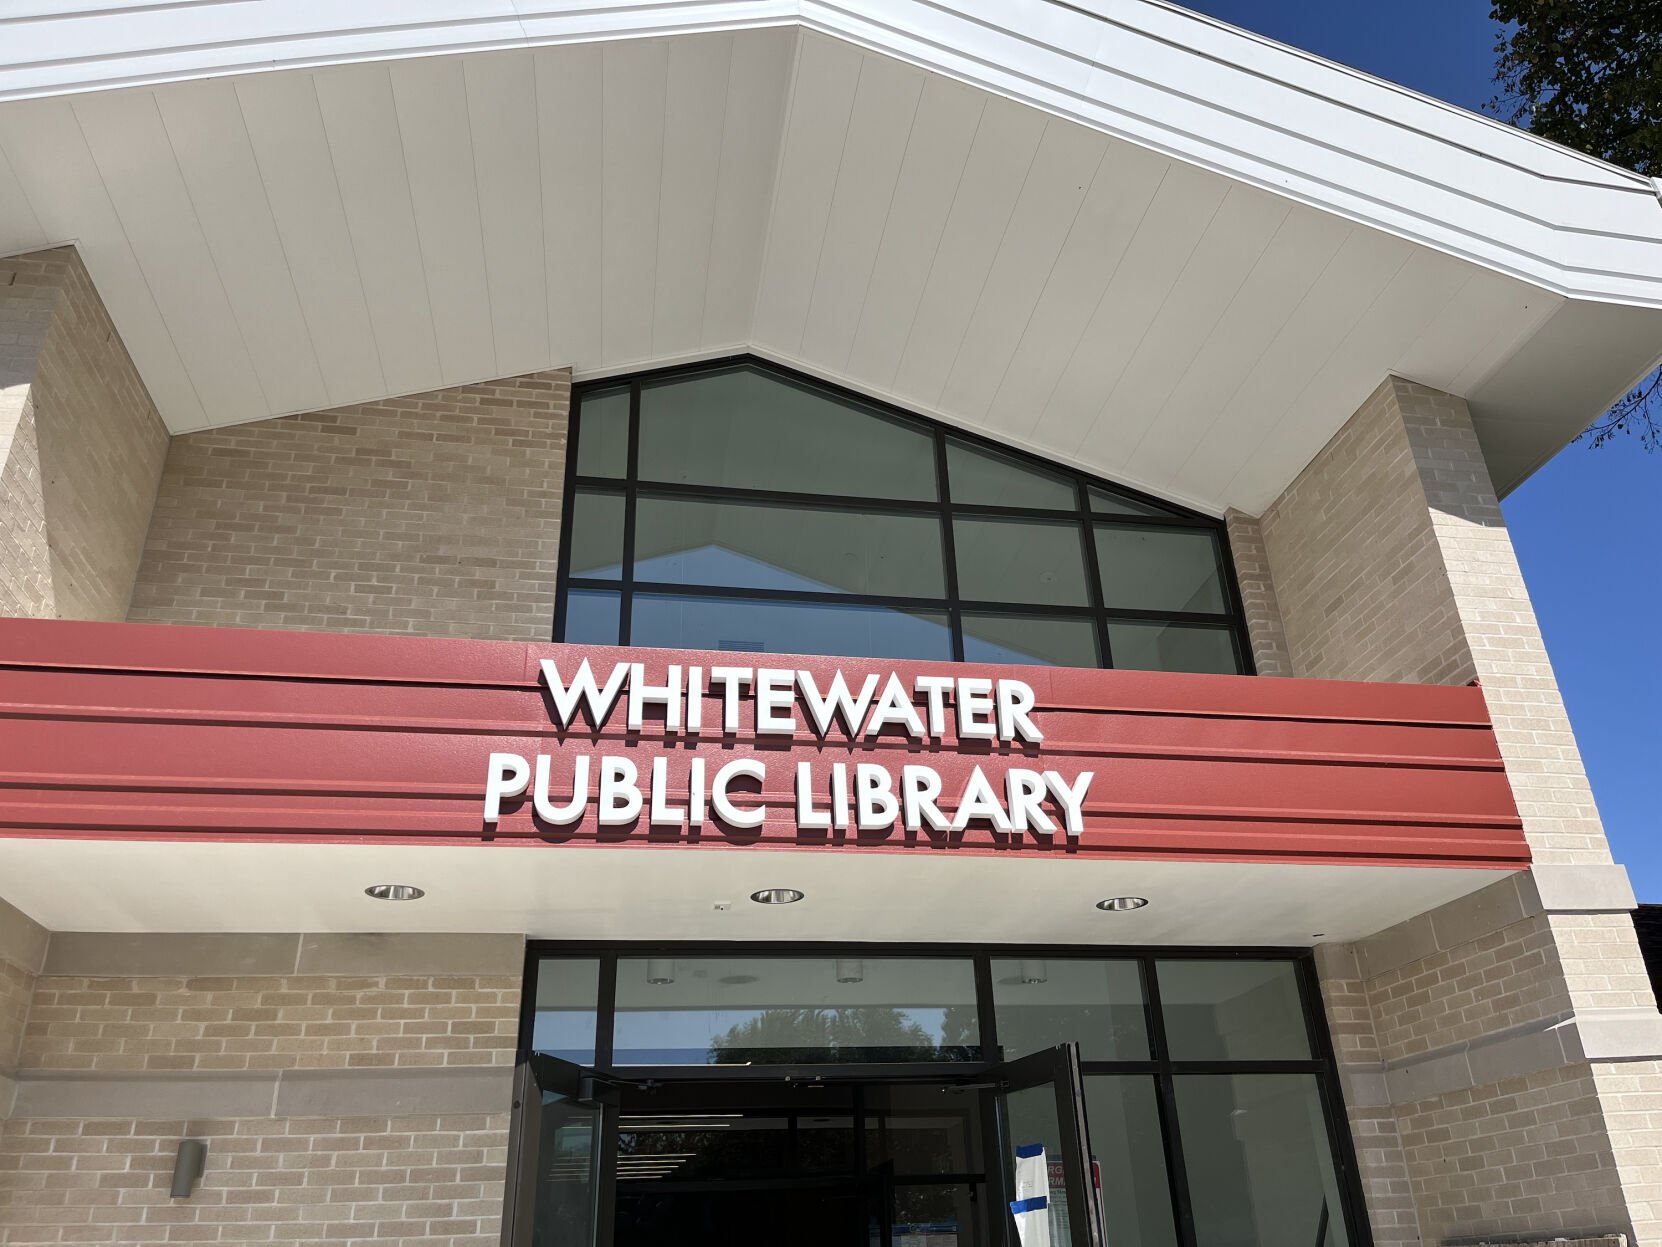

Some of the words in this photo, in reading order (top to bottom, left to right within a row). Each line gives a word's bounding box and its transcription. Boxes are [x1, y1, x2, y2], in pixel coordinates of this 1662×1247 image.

[539, 657, 1043, 744] WHITEWATER
[484, 752, 766, 829] PUBLIC
[797, 761, 1095, 836] LIBRARY
